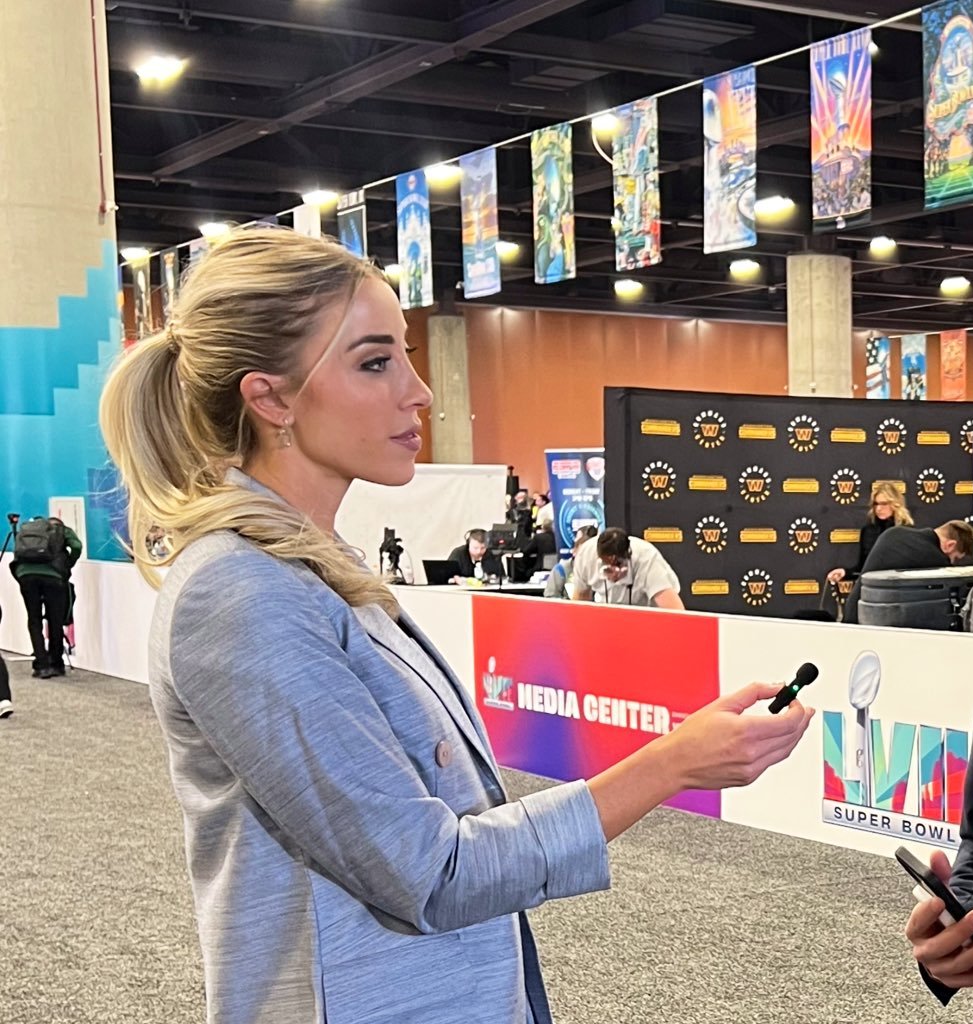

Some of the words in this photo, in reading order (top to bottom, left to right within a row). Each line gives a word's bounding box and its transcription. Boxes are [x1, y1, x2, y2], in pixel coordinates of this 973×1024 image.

[517, 682, 580, 720] MEDIA
[583, 693, 671, 736] CENTER
[822, 710, 969, 826] LVII
[834, 806, 891, 830] SUPER
[902, 820, 956, 843] BOWL
